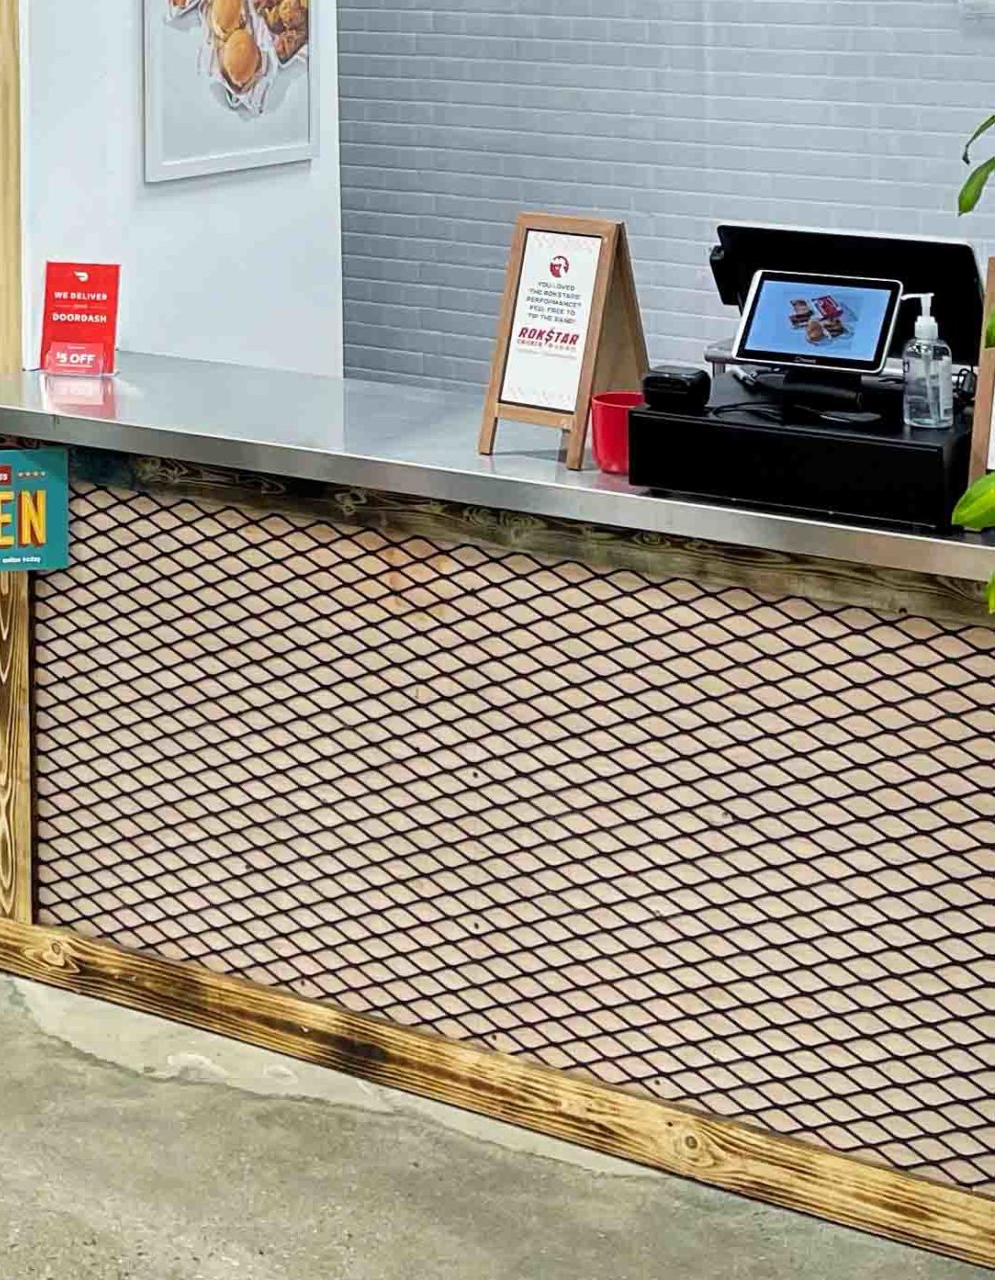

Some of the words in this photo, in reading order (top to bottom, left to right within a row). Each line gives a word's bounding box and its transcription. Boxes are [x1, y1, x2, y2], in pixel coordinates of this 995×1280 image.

[54, 291, 68, 300] WE
[70, 292, 108, 301] DELIVER
[52, 313, 107, 323] DOORDASH
[70, 353, 96, 364] OFF
